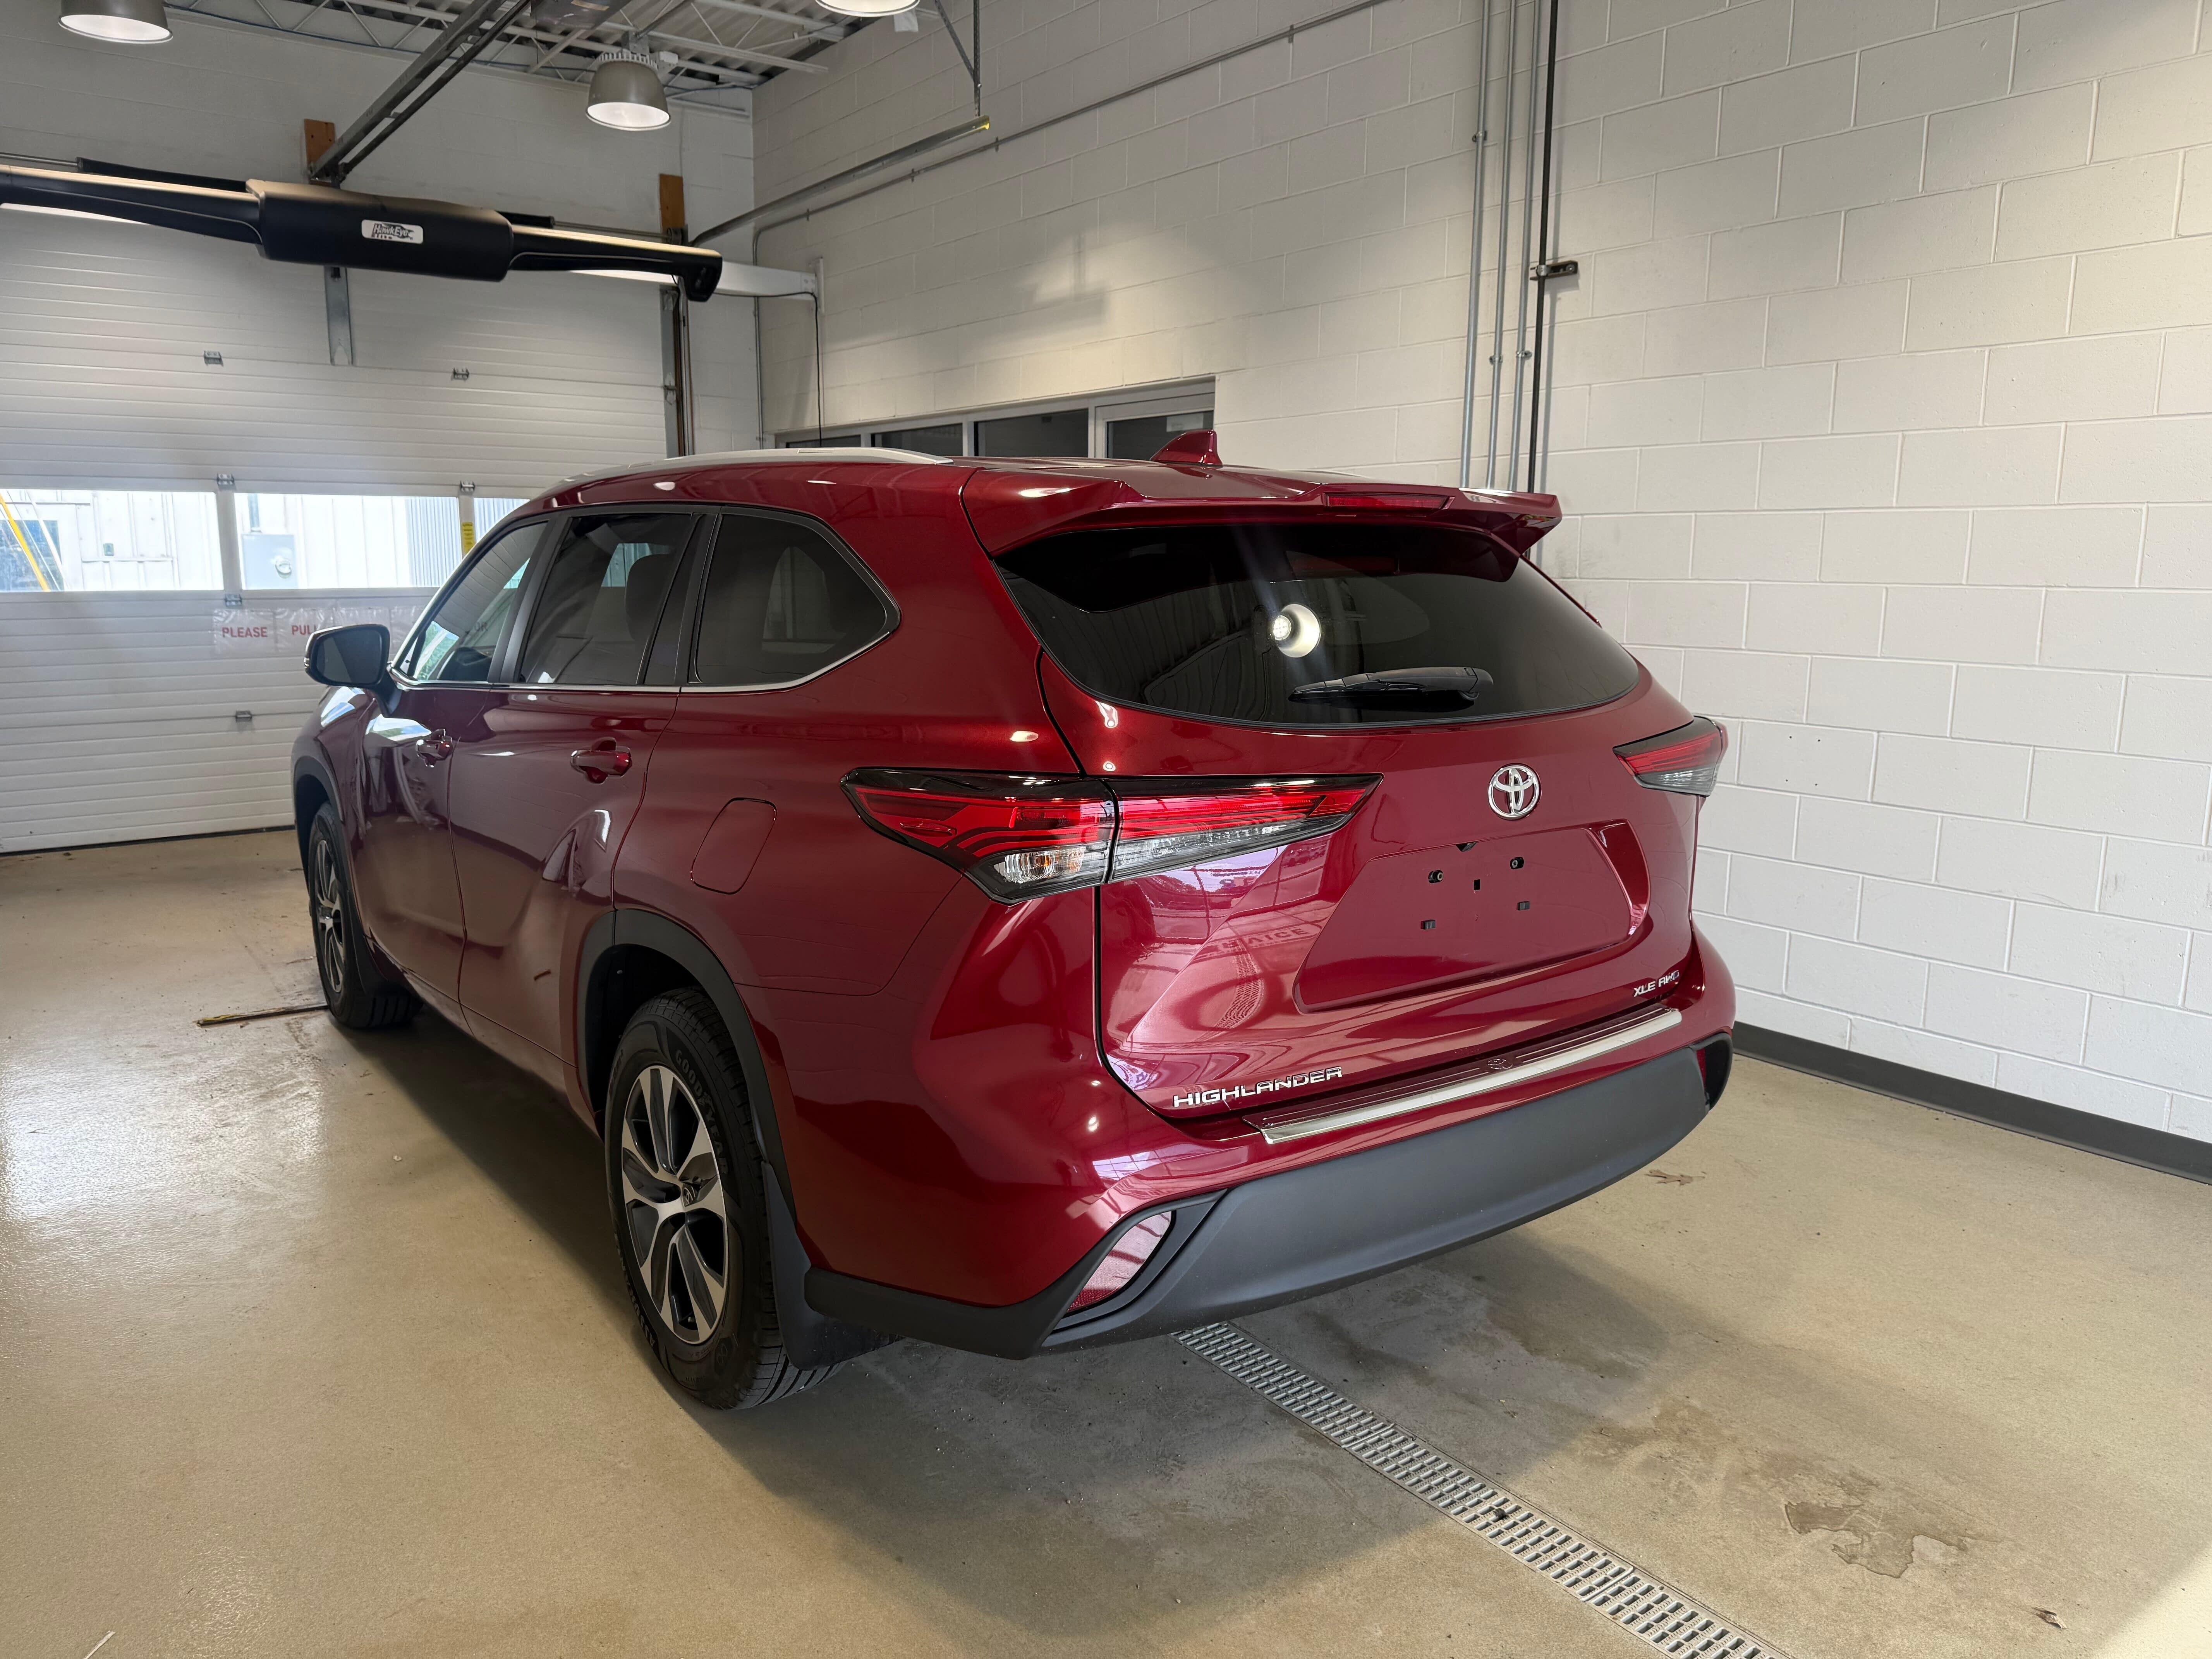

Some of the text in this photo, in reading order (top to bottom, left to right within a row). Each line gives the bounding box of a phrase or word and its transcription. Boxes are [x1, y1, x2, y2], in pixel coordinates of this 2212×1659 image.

[222, 627, 268, 638] PLEASE
[1633, 970, 1680, 997] XLE AWD
[1173, 1066, 1343, 1108] HIGHLANDER
[675, 1049, 728, 1174] GOODYEAR
